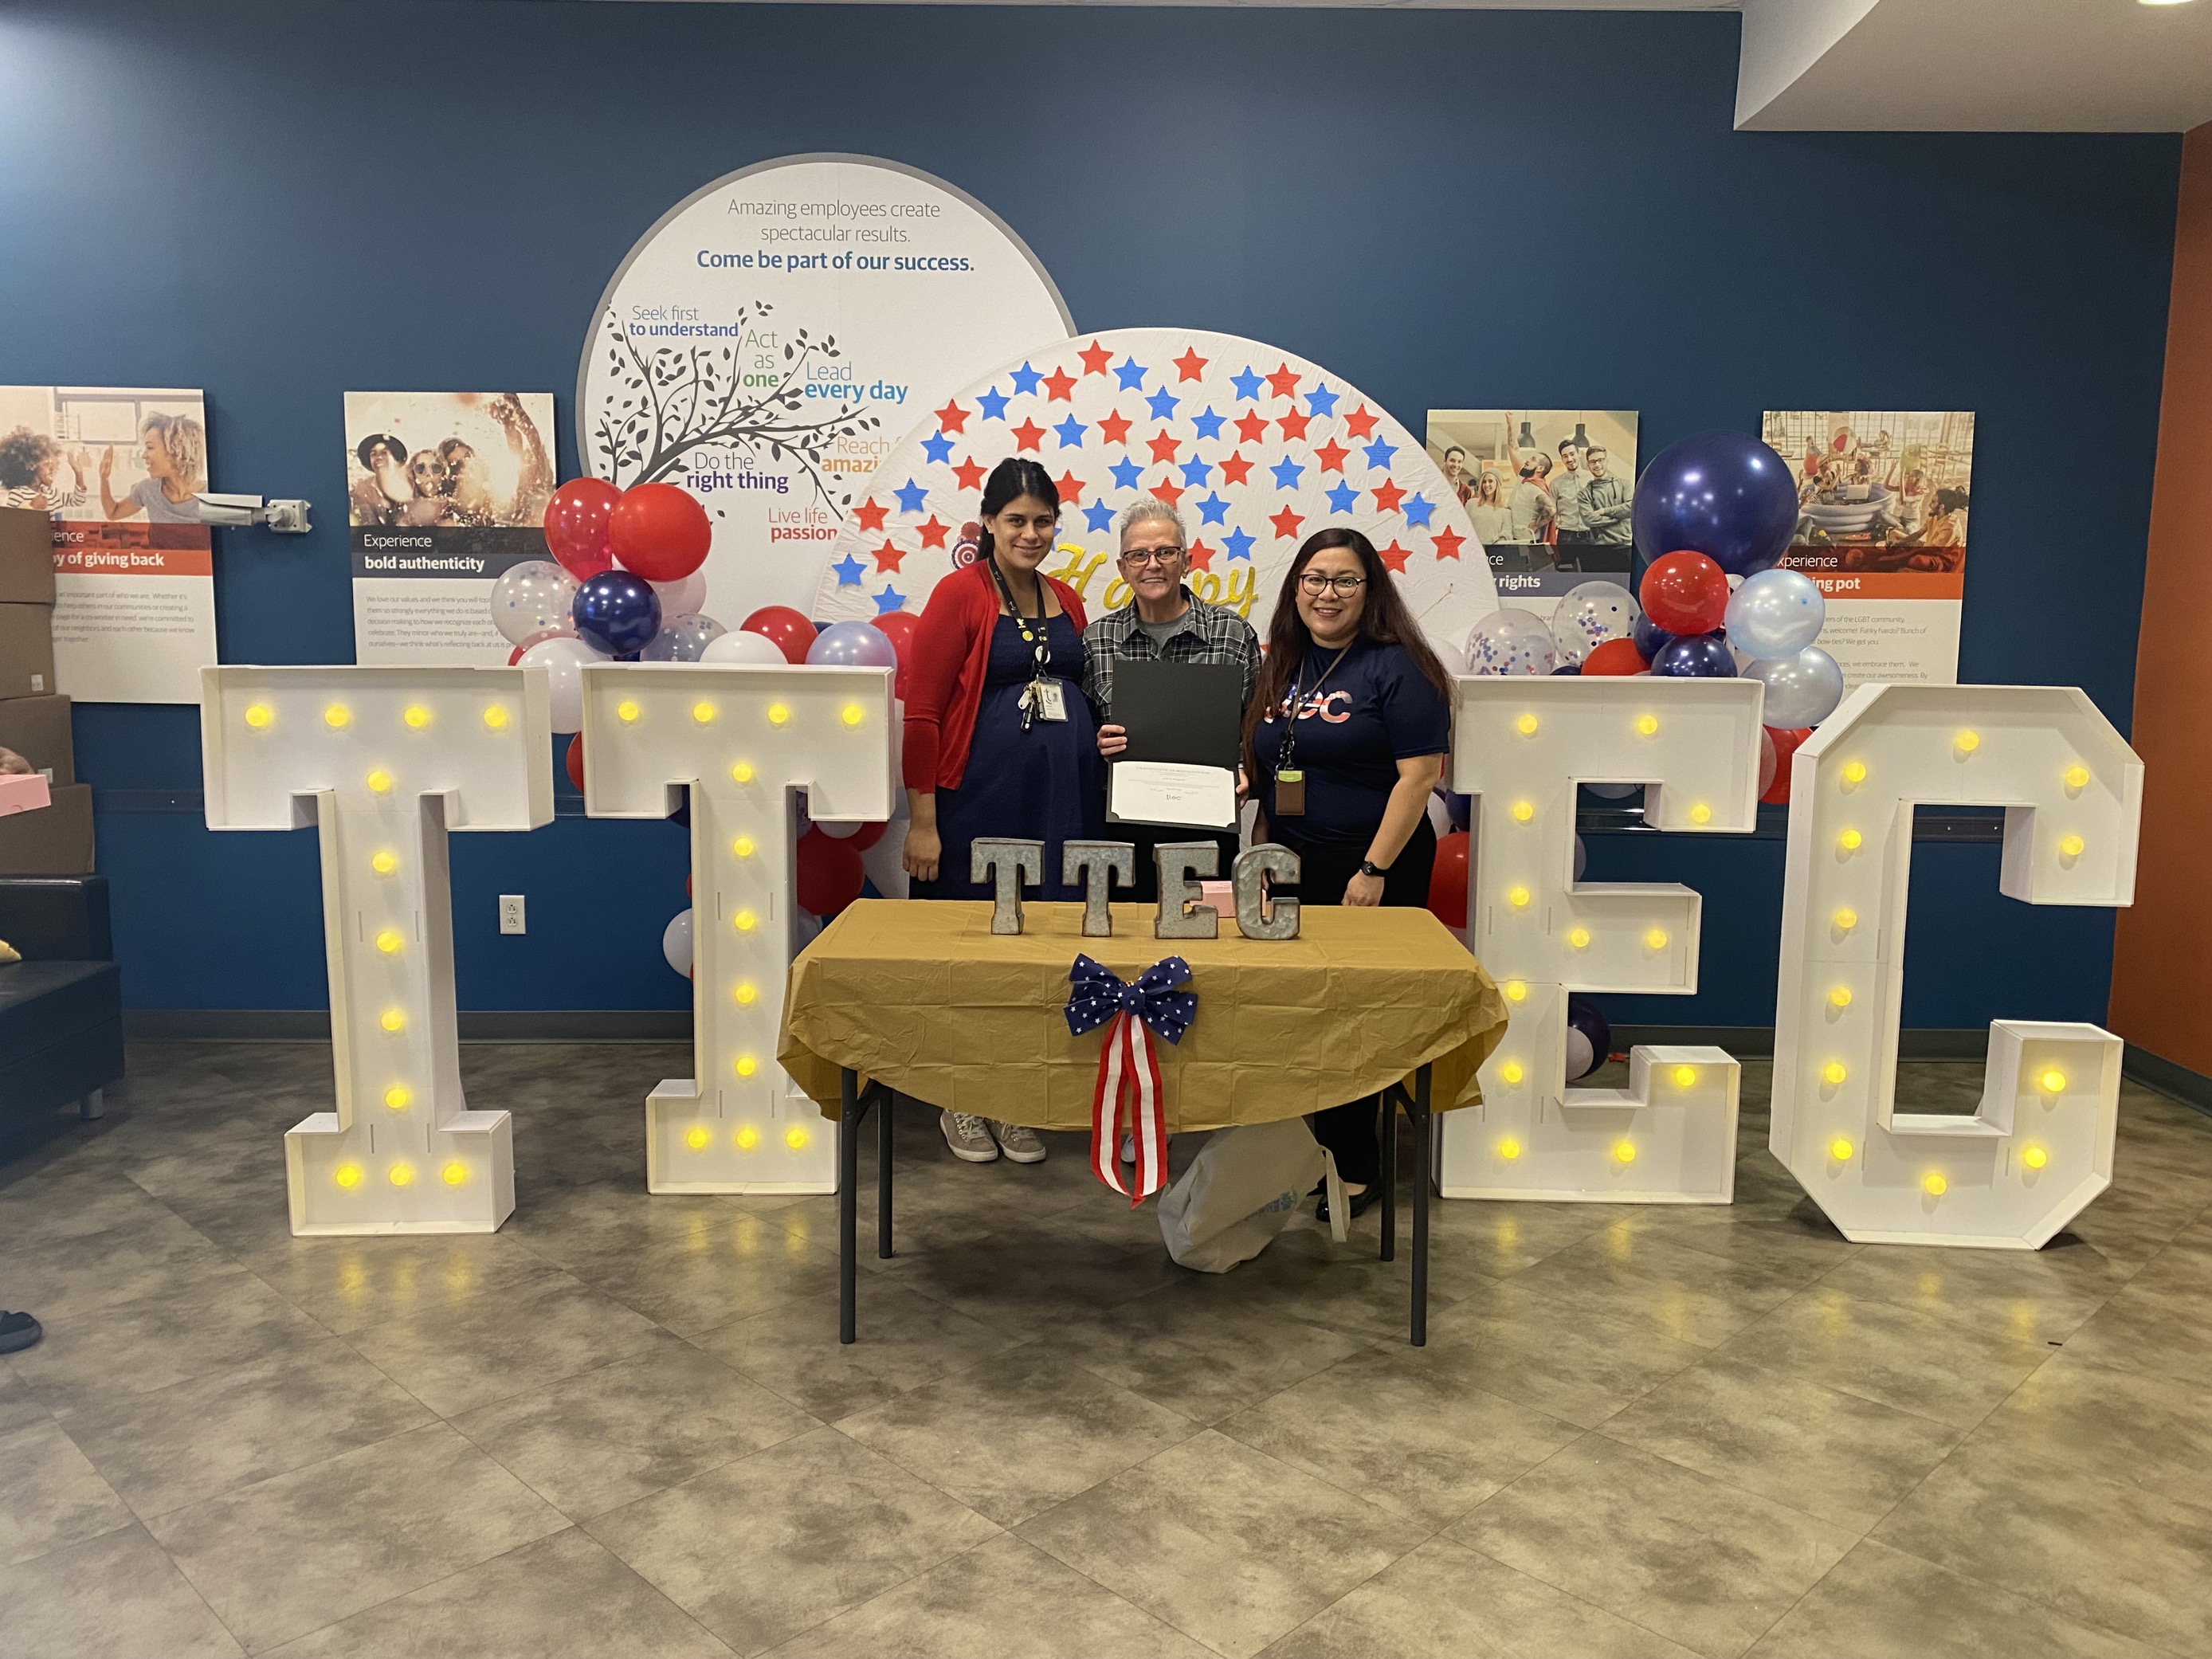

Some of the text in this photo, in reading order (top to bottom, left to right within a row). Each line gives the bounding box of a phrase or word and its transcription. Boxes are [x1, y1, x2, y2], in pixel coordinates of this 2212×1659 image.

[728, 198, 940, 219] Amazing employees create
[761, 225, 910, 244] spectacular results.
[696, 250, 975, 273] Come be part of our success.
[633, 305, 699, 321] Seek first
[629, 322, 739, 337] to understand
[745, 328, 778, 348] Act
[755, 354, 775, 369] as
[806, 362, 852, 381] Lead
[743, 373, 779, 388] one
[805, 380, 908, 404] every day
[837, 436, 890, 454] Reach
[695, 452, 754, 470] Do the
[821, 456, 878, 473] amazi
[687, 471, 789, 494] right thing
[769, 507, 828, 524] Live life
[52, 531, 84, 543] ience
[363, 535, 432, 549] Experience
[771, 524, 837, 543] passion
[68, 551, 82, 564] of
[84, 552, 129, 568] giving
[131, 553, 165, 567] back
[365, 556, 484, 573] bold authenticity
[1777, 555, 1837, 570] xperience
[1500, 575, 1540, 590] rights
[1836, 578, 1861, 593] pot
[971, 837, 1300, 940] TTEC
